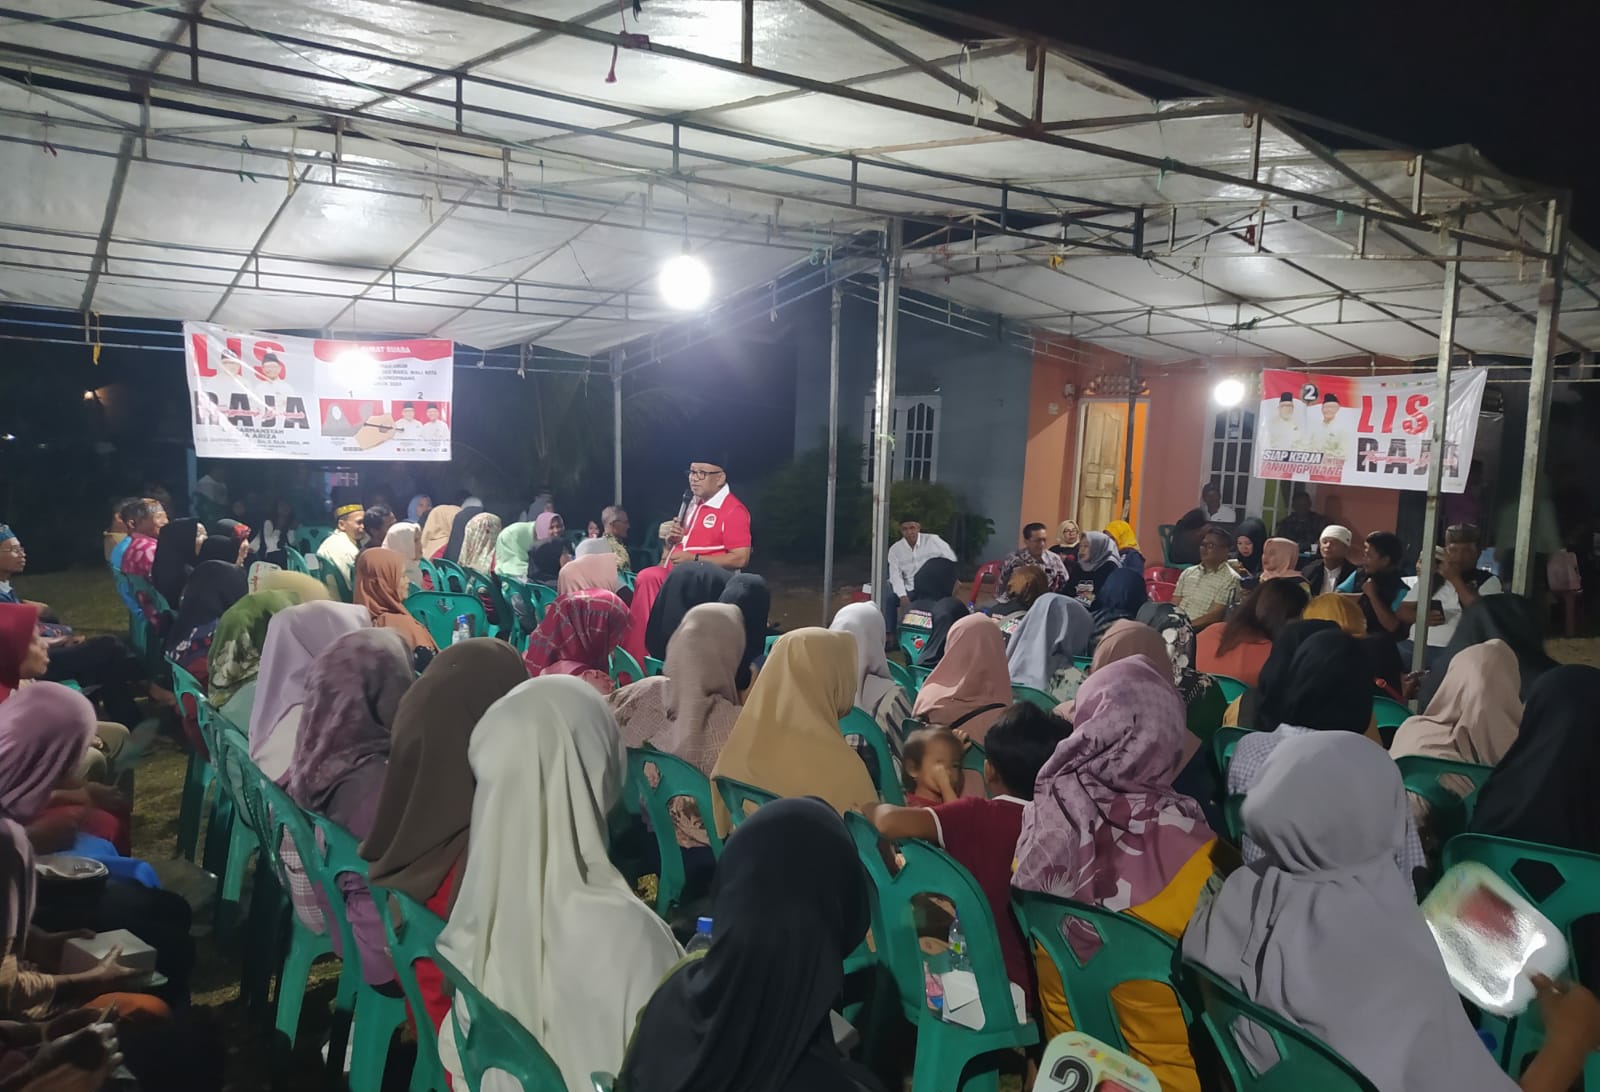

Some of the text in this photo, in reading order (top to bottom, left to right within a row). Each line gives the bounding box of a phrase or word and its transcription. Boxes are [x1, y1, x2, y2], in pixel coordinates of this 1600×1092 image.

[417, 391, 424, 400] 2
[1303, 384, 1317, 400] 2
[193, 391, 310, 430] RAJA
[1357, 394, 1430, 436] LIS
[1263, 450, 1289, 461] SIAP
[1289, 452, 1322, 464] KERJA
[1049, 1055, 1093, 1092] 2
